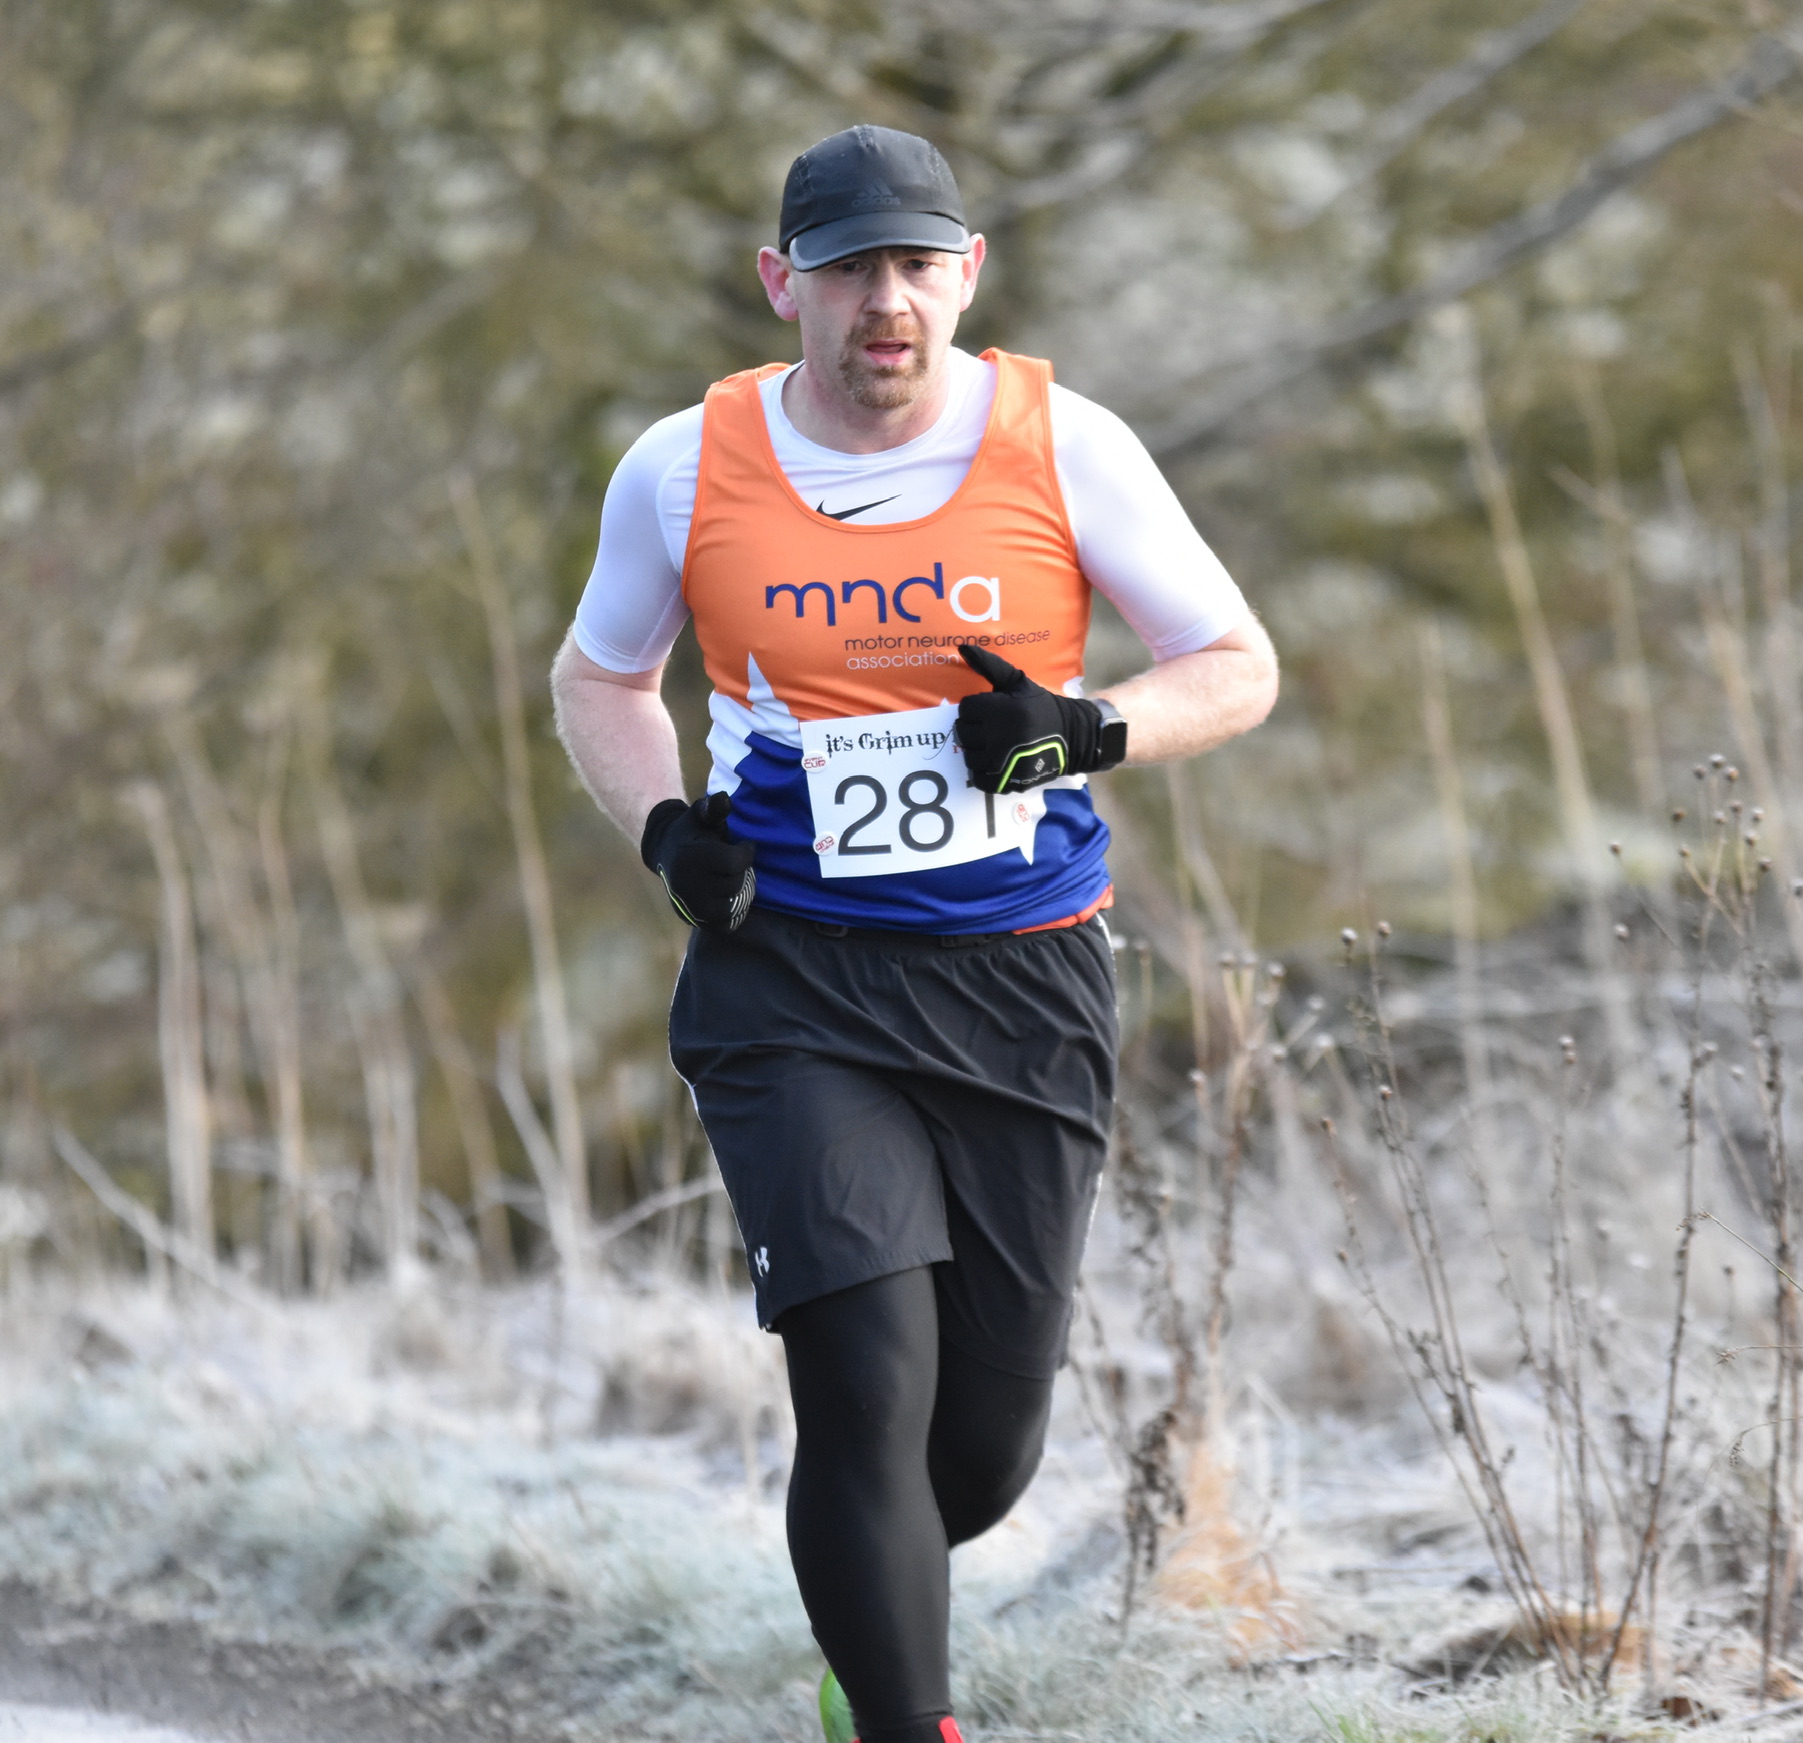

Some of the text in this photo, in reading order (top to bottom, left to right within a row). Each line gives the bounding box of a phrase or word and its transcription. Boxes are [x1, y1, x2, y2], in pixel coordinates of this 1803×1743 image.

[765, 562, 1000, 626] mnda
[844, 629, 1051, 651] motor neurone disease
[846, 651, 960, 670] association
[826, 733, 854, 758] it's
[858, 730, 913, 755] Grim
[916, 731, 946, 750] up
